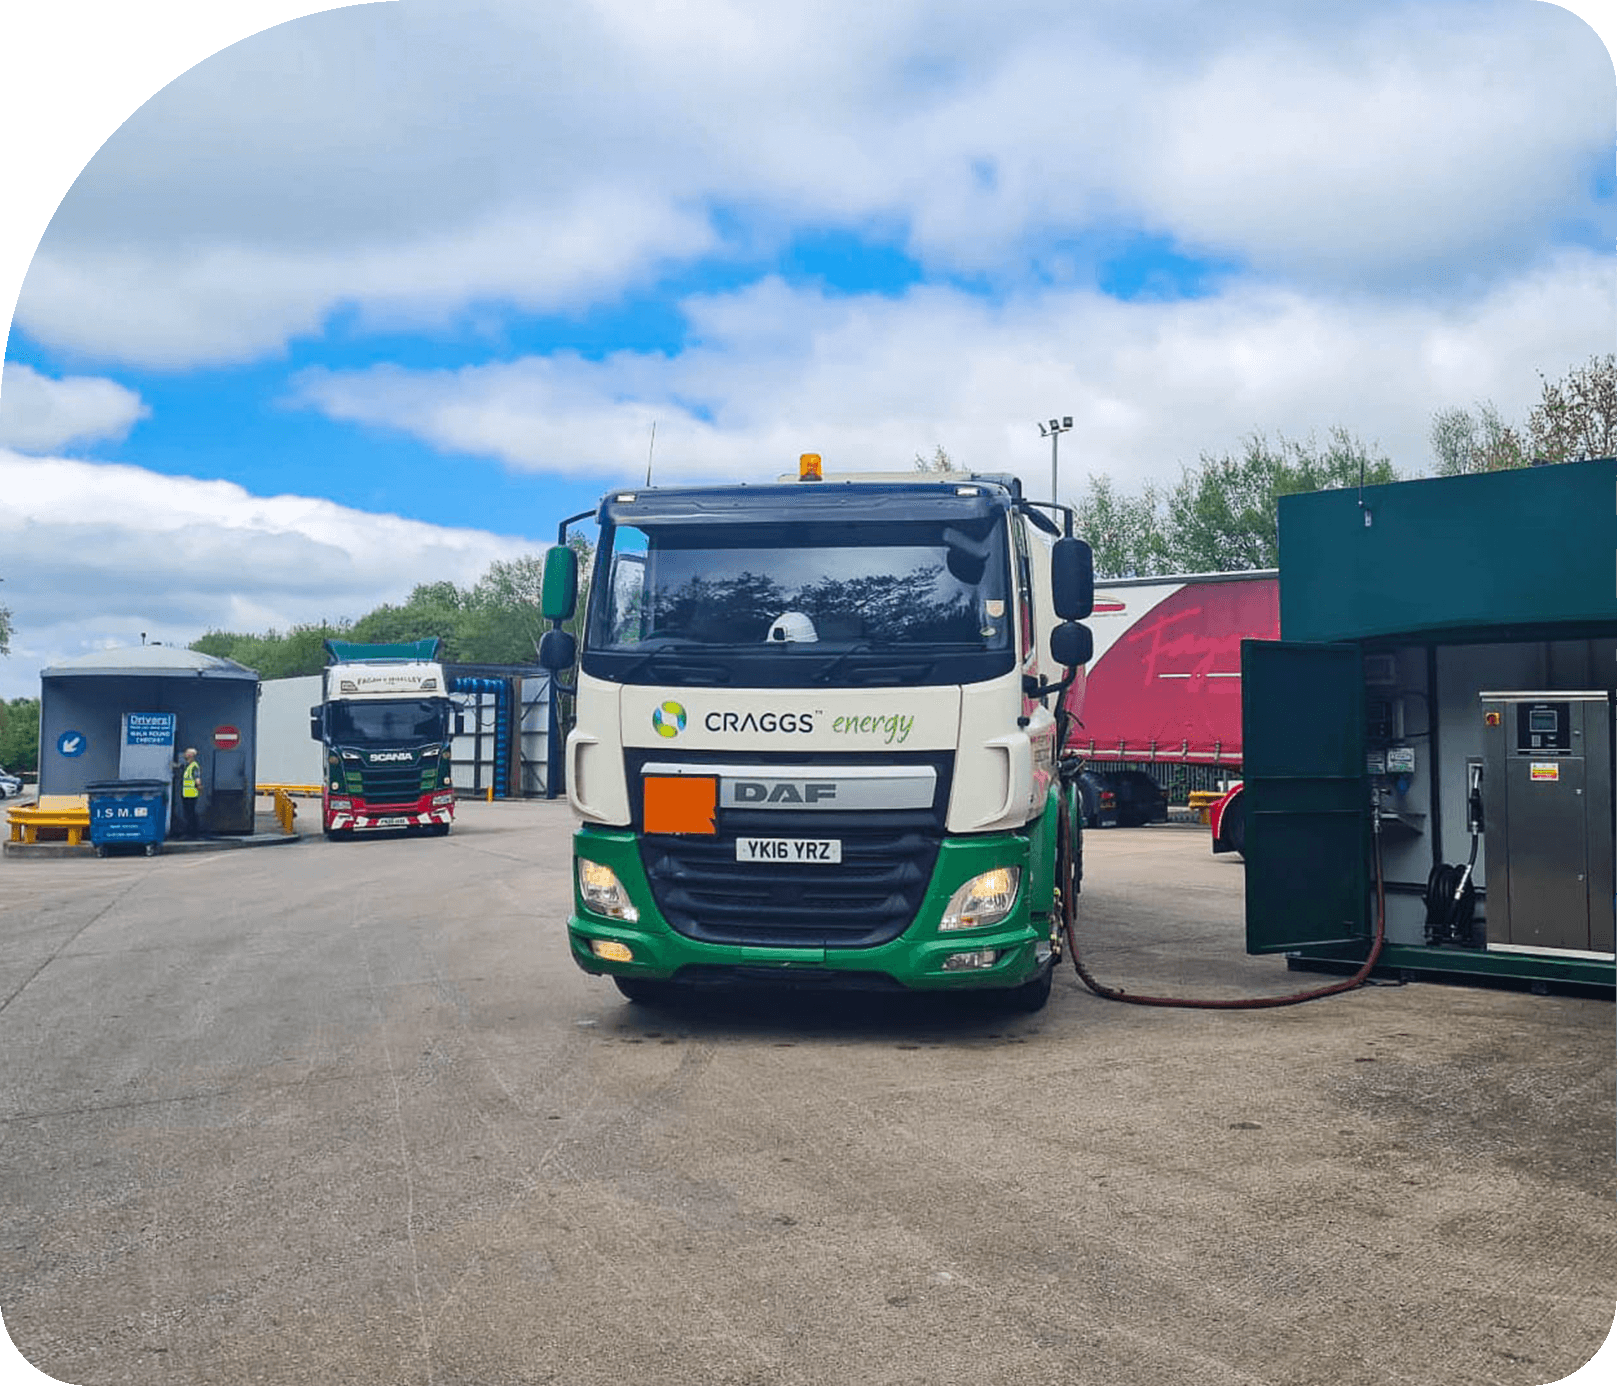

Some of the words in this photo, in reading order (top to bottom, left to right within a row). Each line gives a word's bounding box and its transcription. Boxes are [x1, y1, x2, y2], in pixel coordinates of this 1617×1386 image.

[705, 712, 813, 733] CRAGGS
[832, 714, 914, 744] energy
[370, 752, 413, 762] SCANIA
[735, 782, 837, 803] DAF
[748, 841, 789, 859] YK16
[794, 842, 831, 860] YRZ
